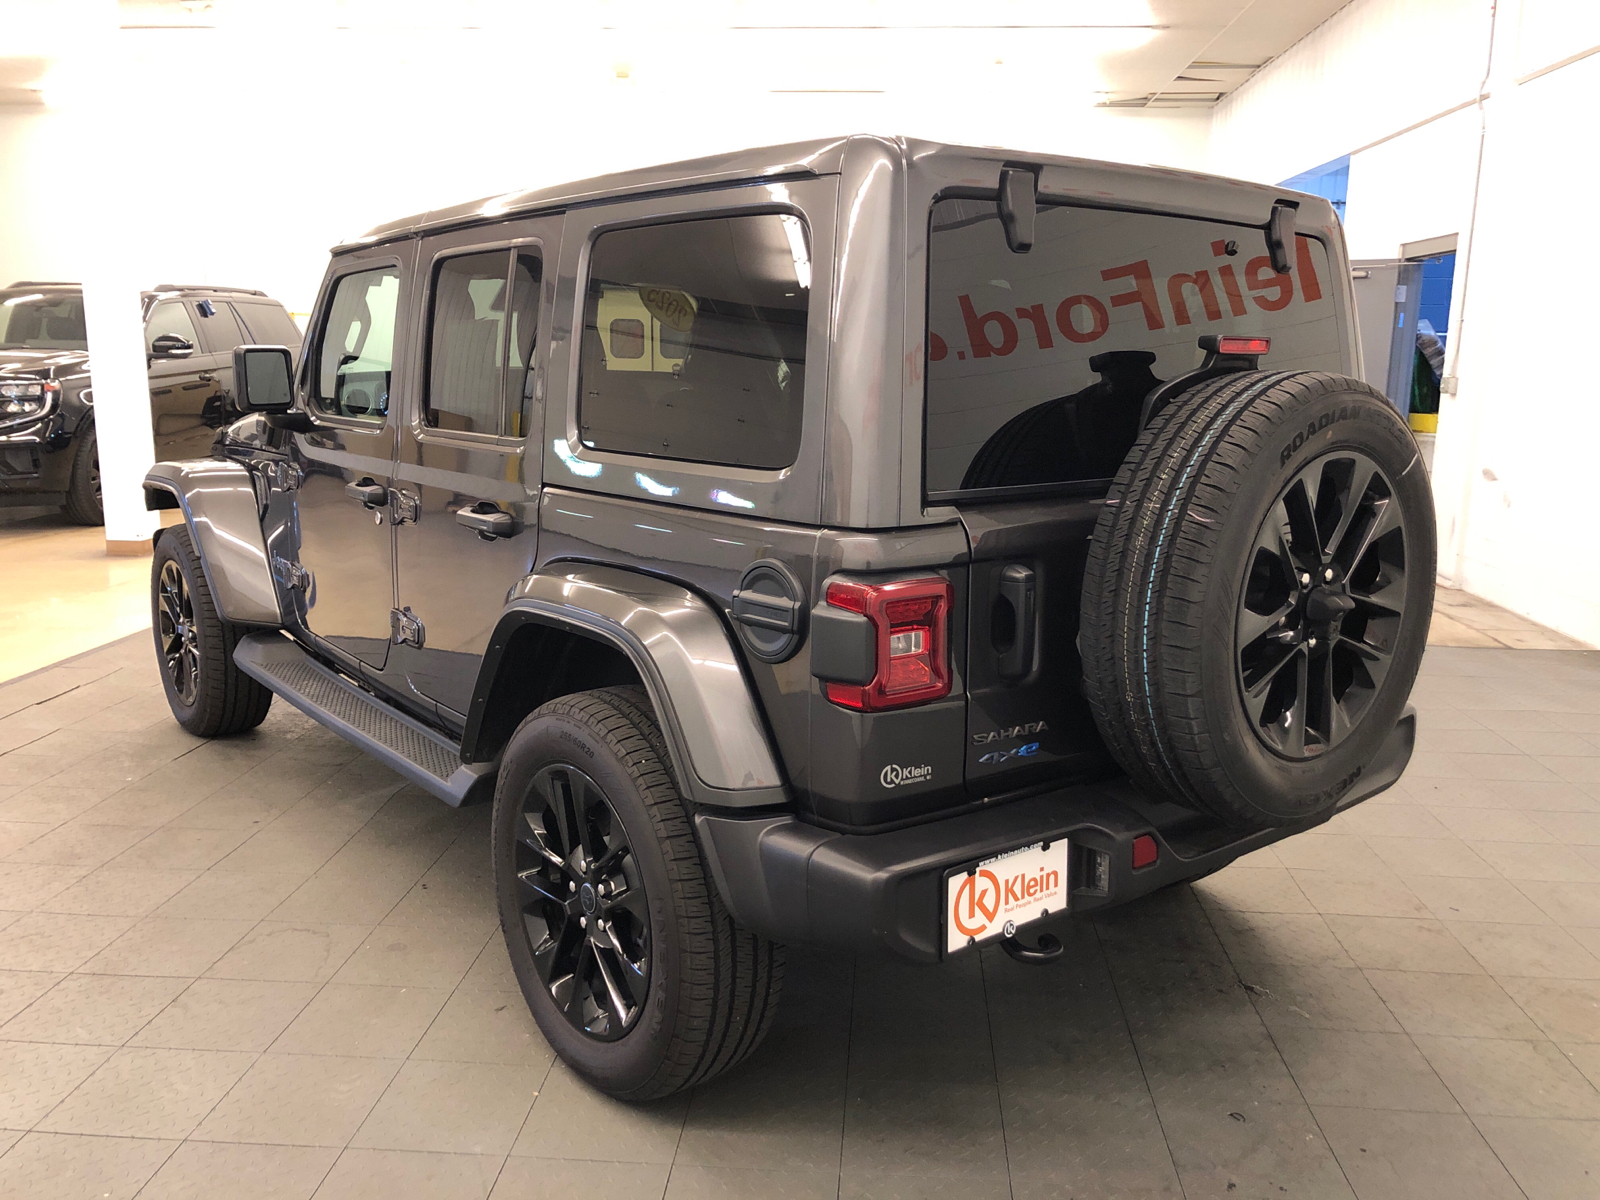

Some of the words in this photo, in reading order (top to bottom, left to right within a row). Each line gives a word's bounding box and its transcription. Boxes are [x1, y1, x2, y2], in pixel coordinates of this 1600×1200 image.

[1279, 405, 1361, 469] ROADIAN
[972, 720, 1049, 746] SAHARA
[903, 764, 932, 779] Klein
[979, 841, 1044, 867] www.kleinauto.com
[1004, 867, 1059, 906] Klein
